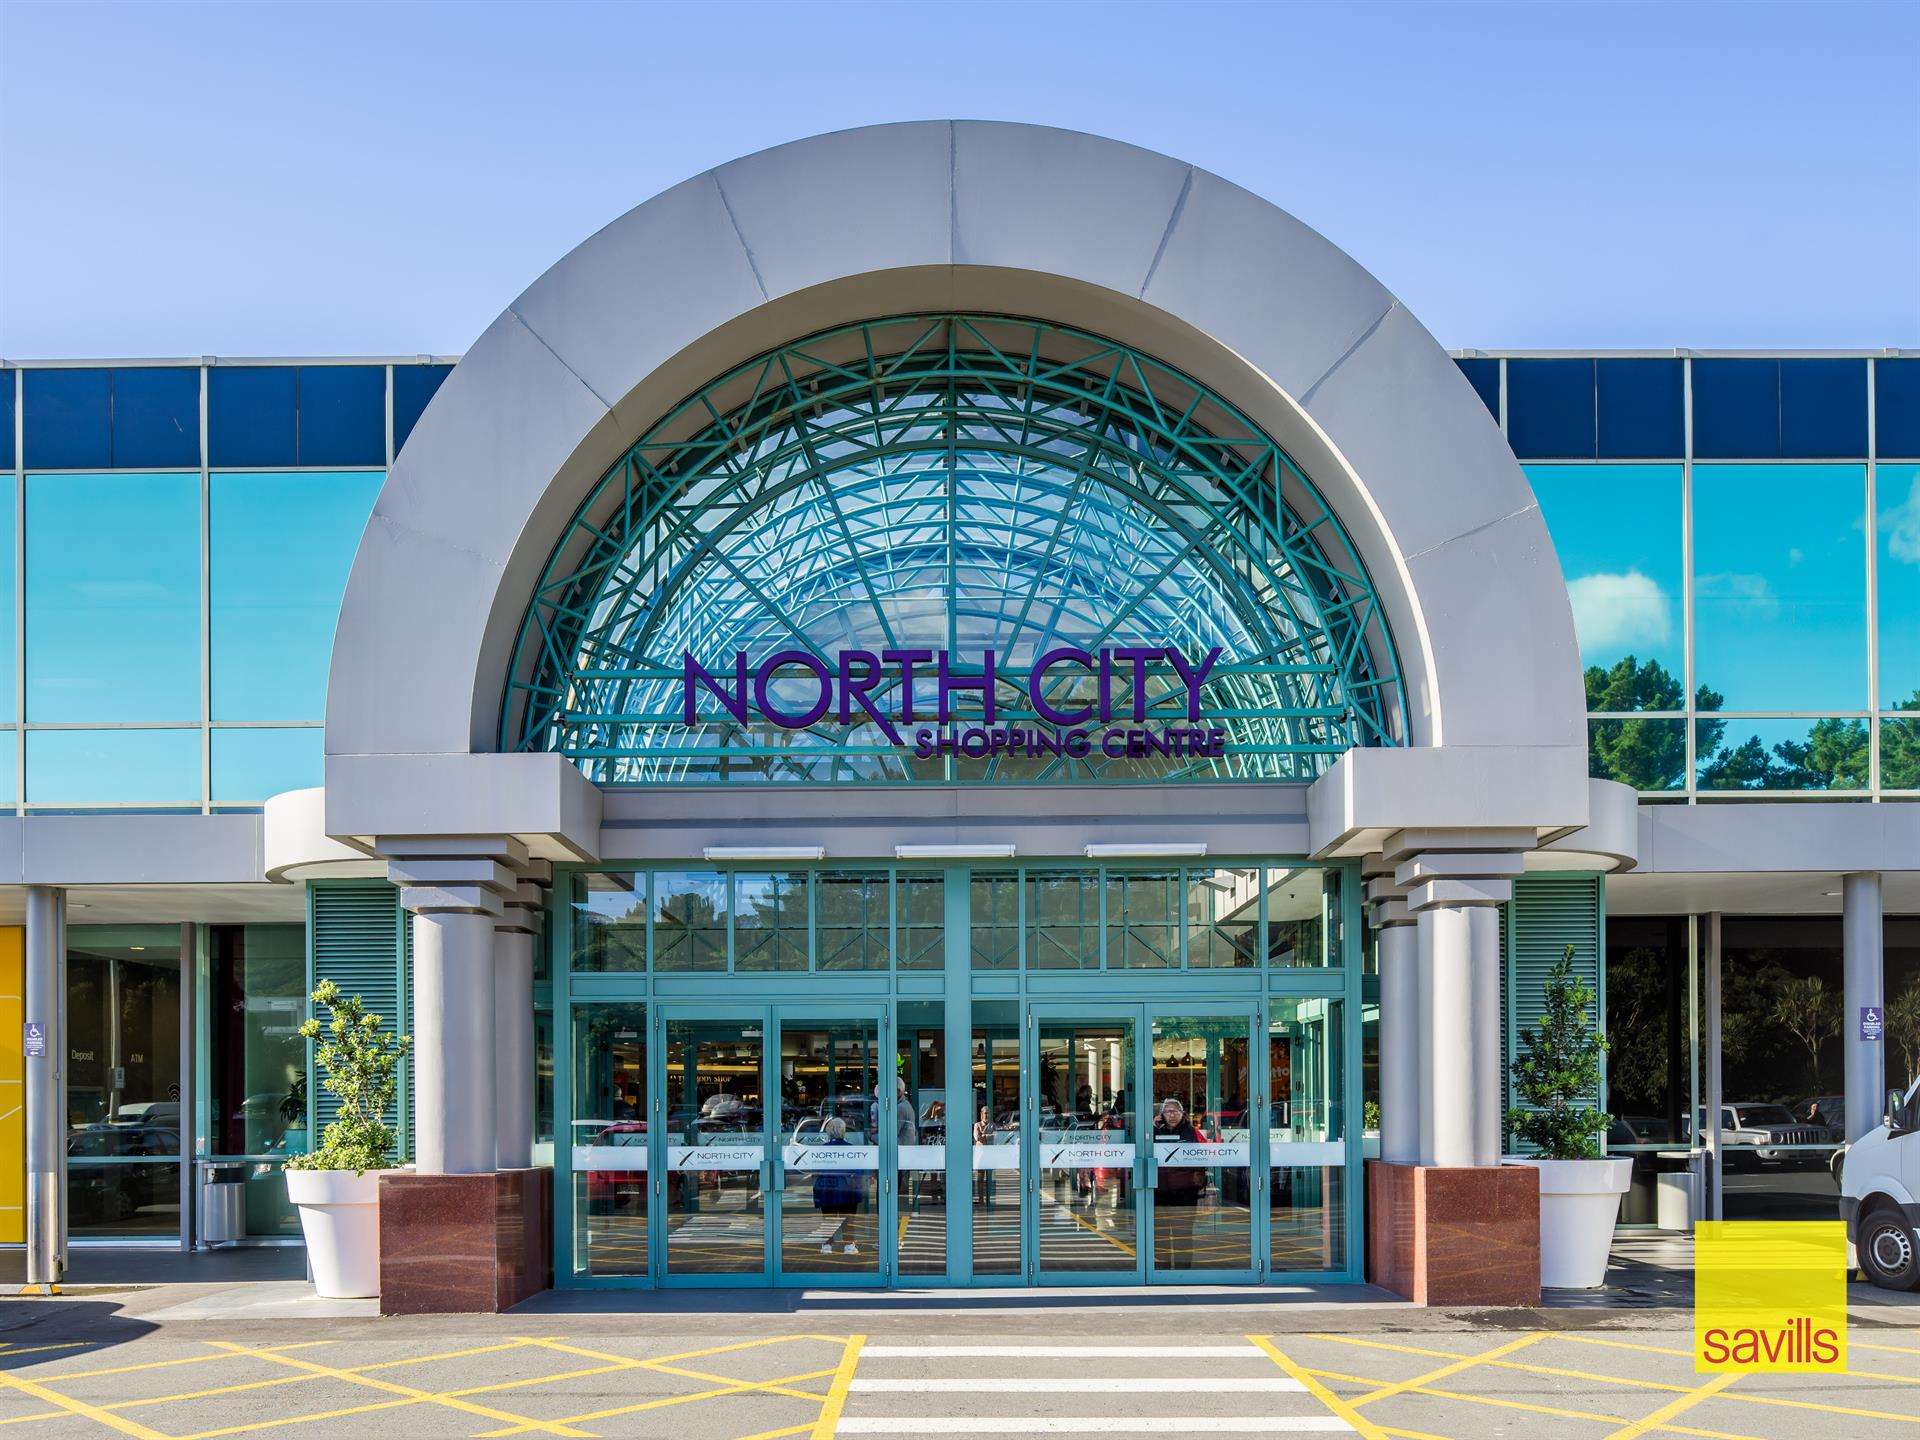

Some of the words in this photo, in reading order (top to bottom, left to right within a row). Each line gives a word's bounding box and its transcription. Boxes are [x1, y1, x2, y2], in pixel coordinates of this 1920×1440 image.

[684, 649, 996, 746] NORTH
[1029, 646, 1224, 726] CITY
[914, 727, 1092, 760] SHOPPING
[1101, 727, 1226, 760] CENTRE
[72, 1049, 94, 1061] Deposit
[130, 1054, 144, 1063] ATM
[697, 1152, 731, 1160] NORTH
[732, 1152, 754, 1160] CITY
[811, 1151, 845, 1159] NORTH
[846, 1151, 868, 1159] CITY
